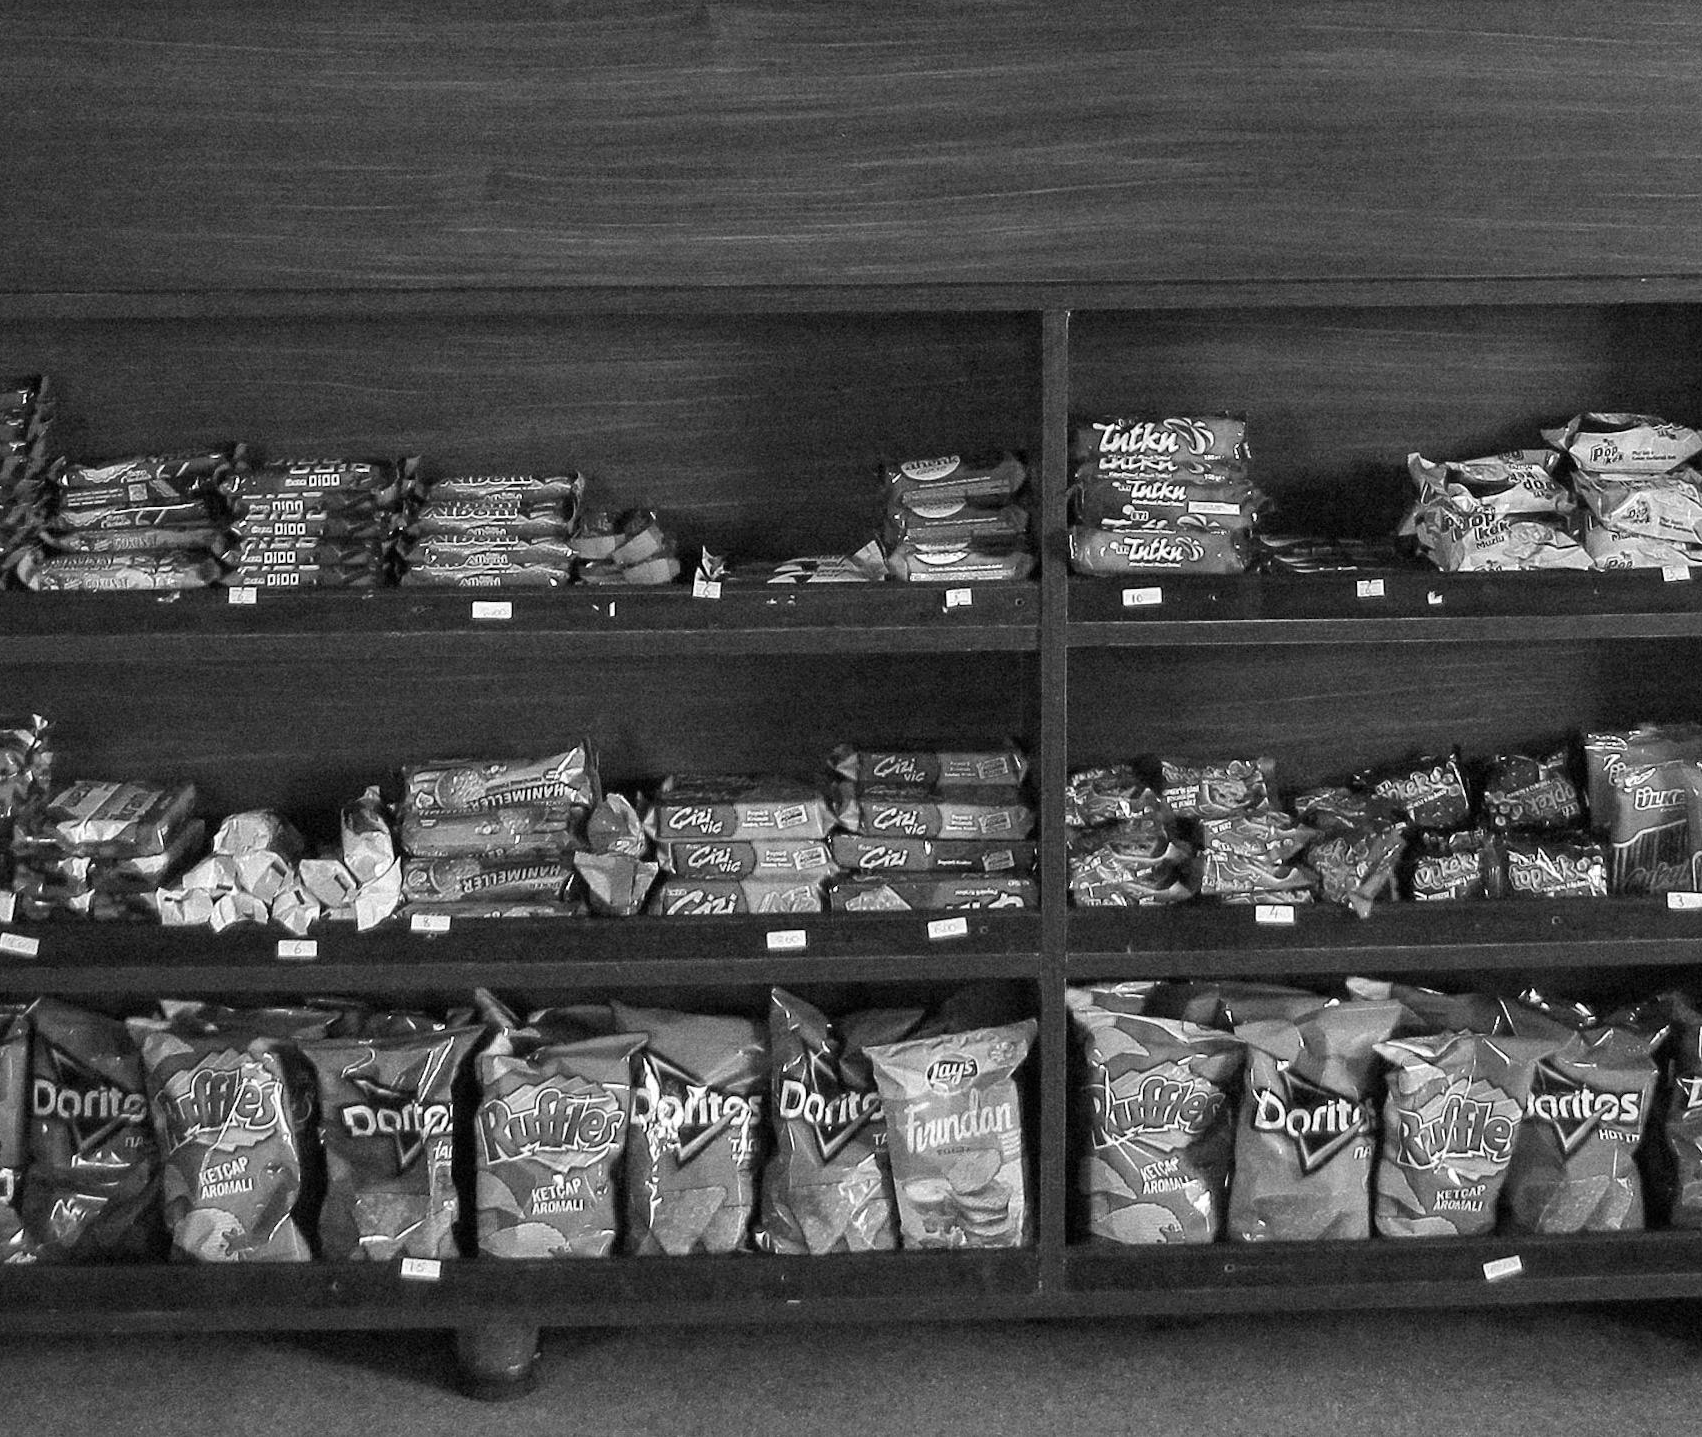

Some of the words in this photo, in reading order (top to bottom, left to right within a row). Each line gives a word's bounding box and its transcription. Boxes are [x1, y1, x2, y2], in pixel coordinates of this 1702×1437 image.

[1092, 422, 1180, 453] Tutku
[1126, 479, 1187, 500] Tutku
[1123, 538, 1185, 562] Tutku
[1634, 787, 1686, 810] ÜLKE
[476, 1087, 626, 1165] Ruffles
